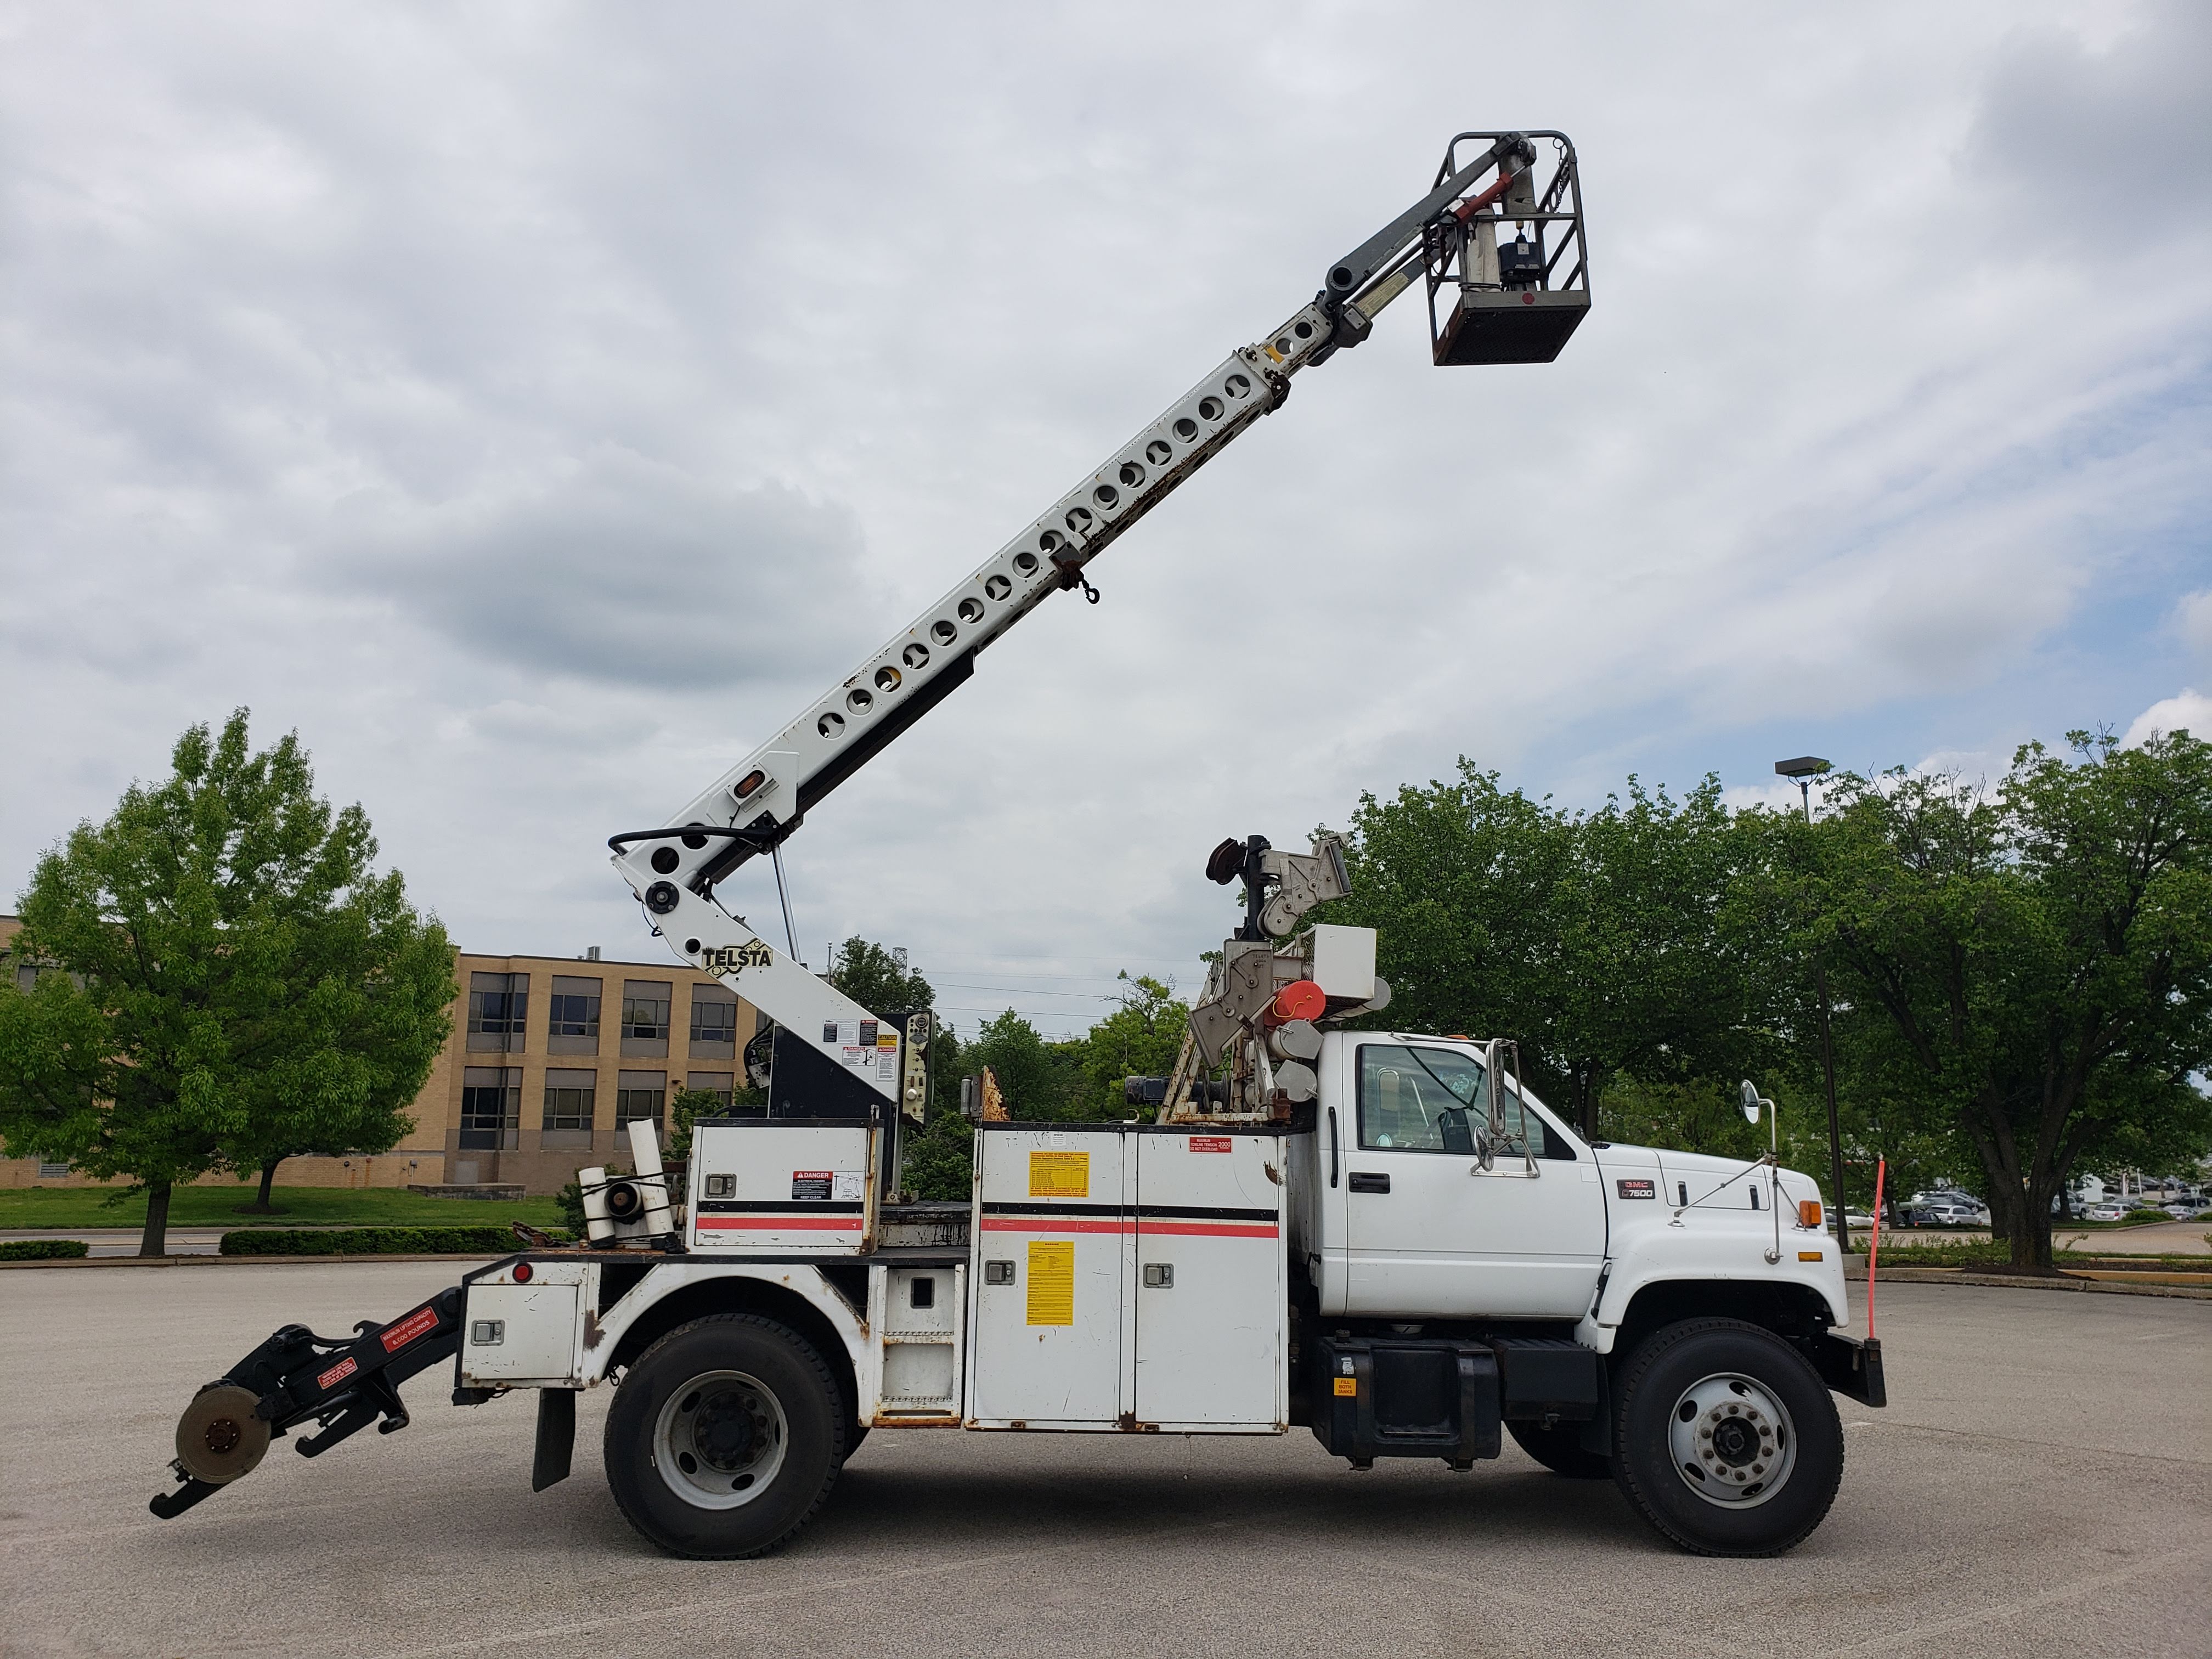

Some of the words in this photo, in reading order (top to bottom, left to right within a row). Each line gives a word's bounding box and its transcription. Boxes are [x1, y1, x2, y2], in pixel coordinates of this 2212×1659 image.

[703, 950, 771, 966] TELSTA
[399, 1320, 415, 1331] LIFTING
[413, 1310, 431, 1323] CAPACITY
[408, 1320, 430, 1336] POUNDS
